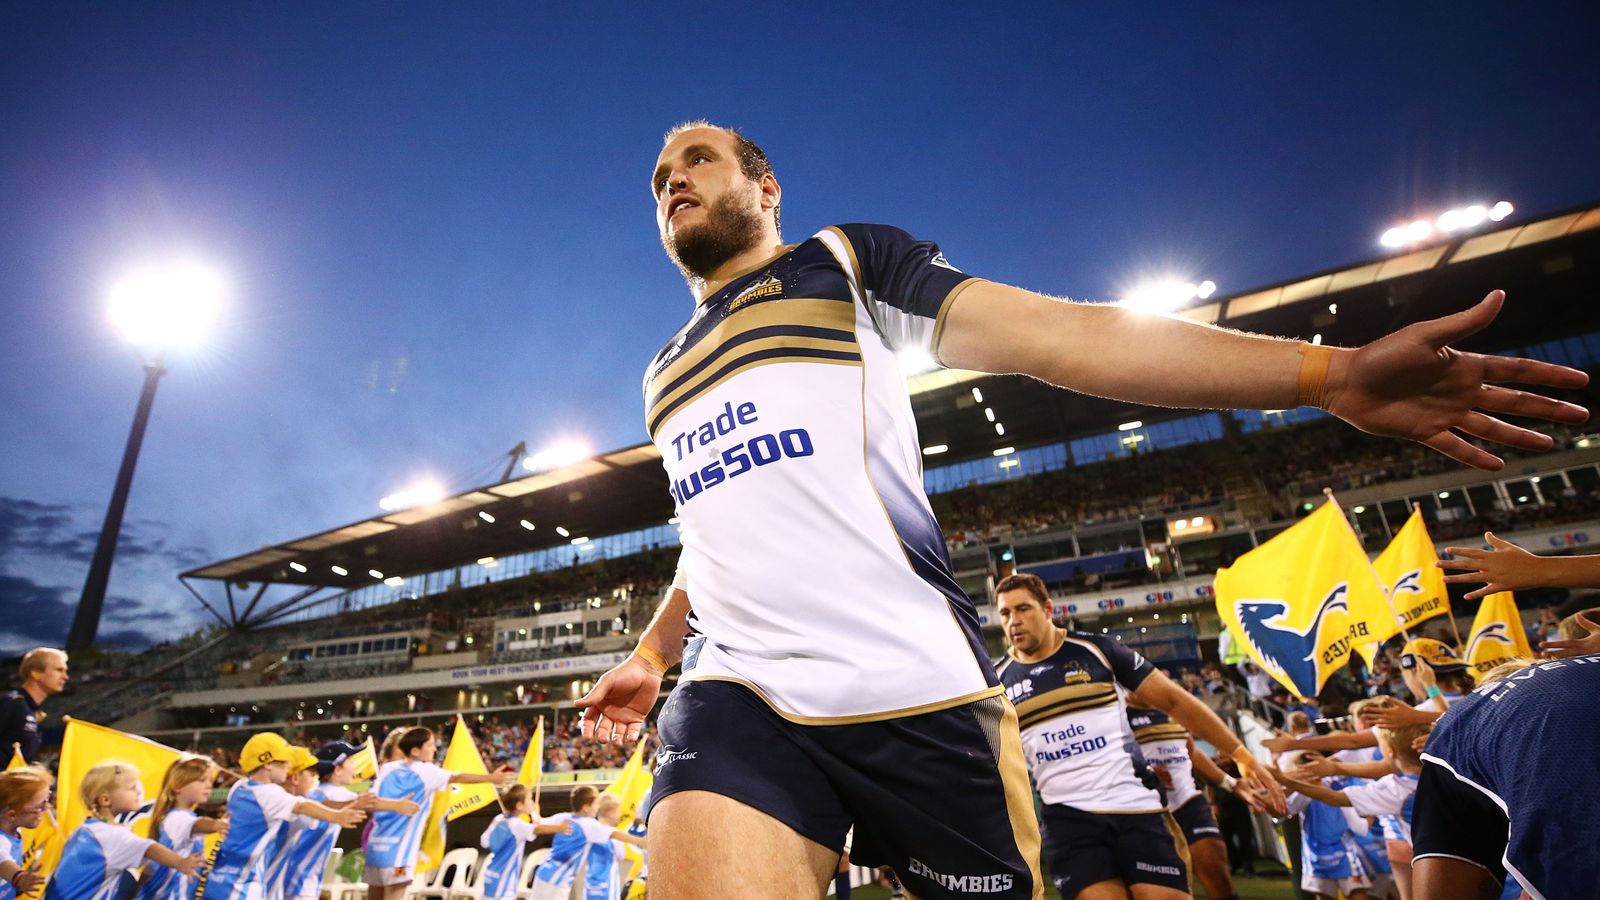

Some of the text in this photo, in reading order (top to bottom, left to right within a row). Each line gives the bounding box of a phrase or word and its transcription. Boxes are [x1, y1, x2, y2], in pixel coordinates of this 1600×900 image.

[672, 401, 758, 462] Trade
[671, 428, 814, 506] lus500
[1036, 735, 1107, 765] Plus500
[1042, 723, 1086, 744] Trade
[669, 751, 698, 764] CLASSIC
[908, 857, 1014, 893] BRUMBIES
